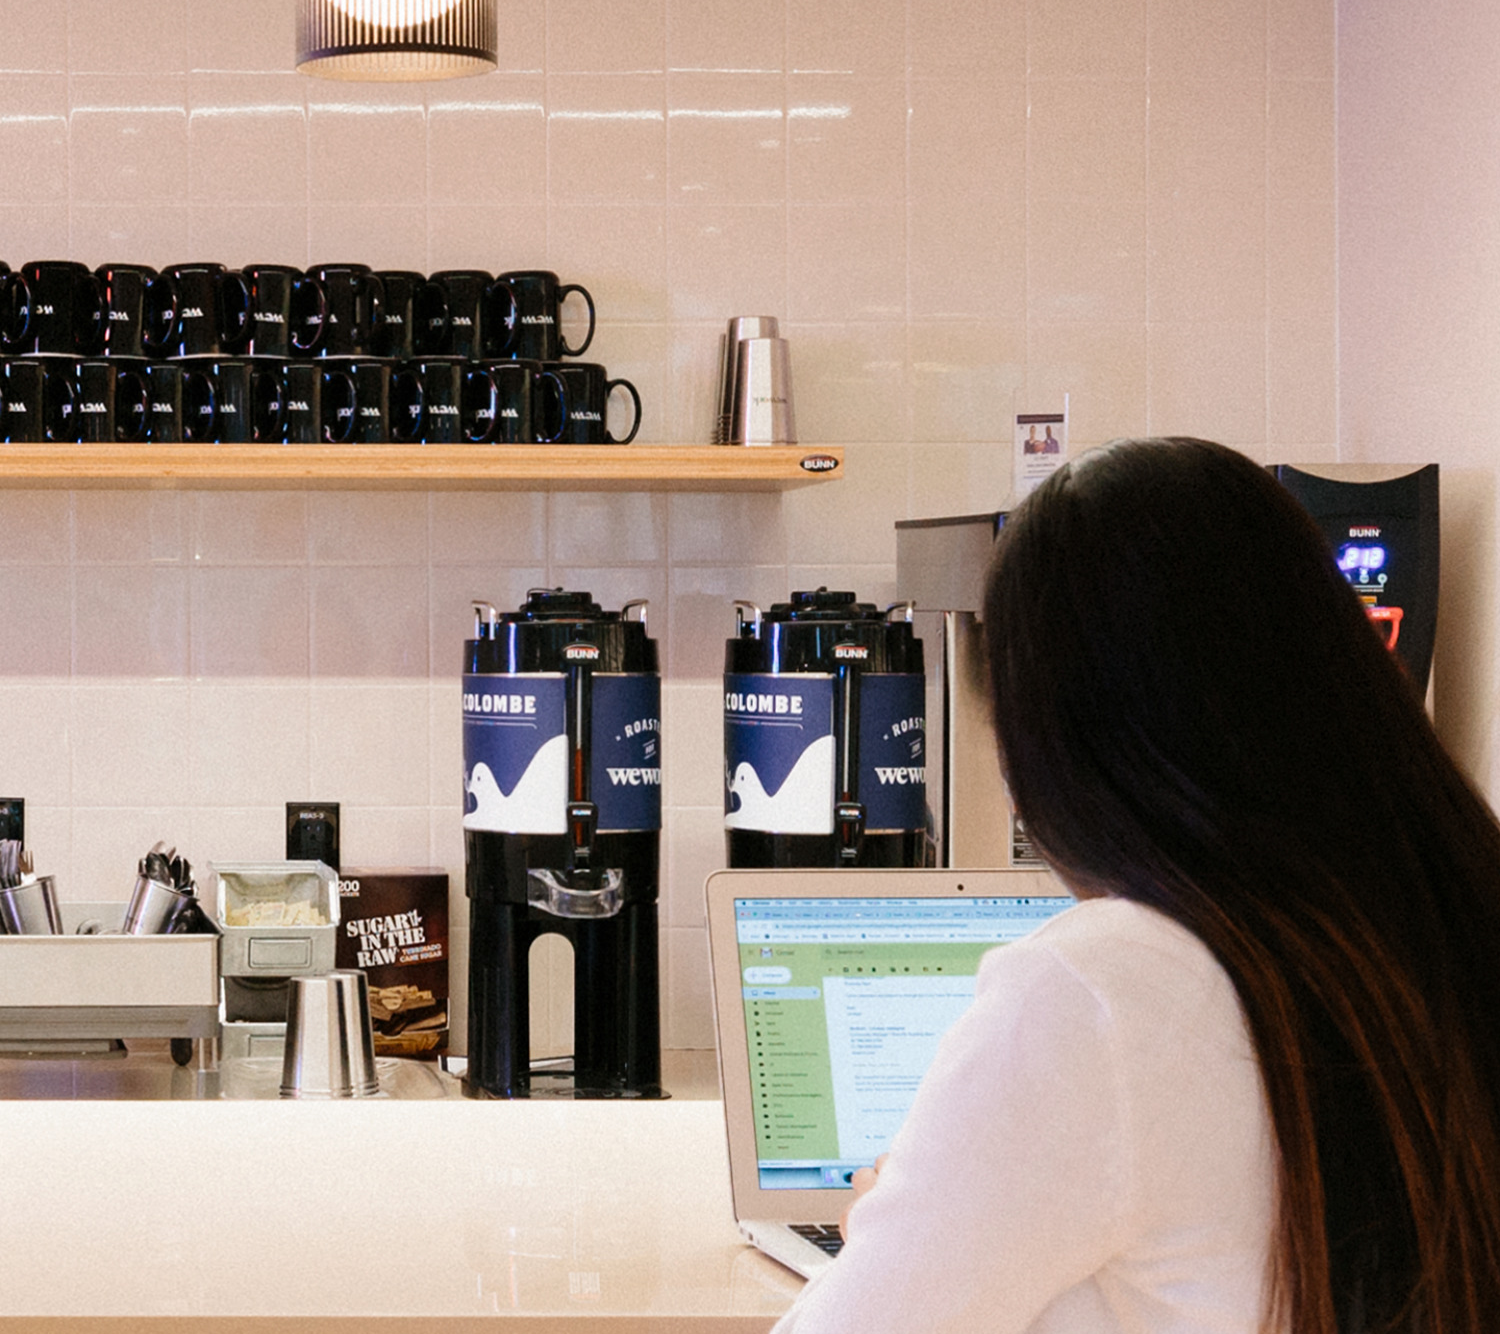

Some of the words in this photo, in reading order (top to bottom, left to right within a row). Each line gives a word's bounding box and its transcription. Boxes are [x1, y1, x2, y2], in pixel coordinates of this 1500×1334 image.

[804, 459, 836, 469] BUNN
[1349, 529, 1380, 538] BUNN
[1345, 548, 1383, 568] 212
[566, 649, 600, 660] BUNN
[835, 648, 868, 659] BUNN
[463, 693, 537, 714] COLOMBE
[726, 692, 803, 714] COLOMBE
[338, 879, 360, 892] 200
[346, 913, 412, 938] SUGAR
[360, 933, 382, 951] IN
[384, 926, 426, 948] THE
[357, 946, 398, 968] RAW
